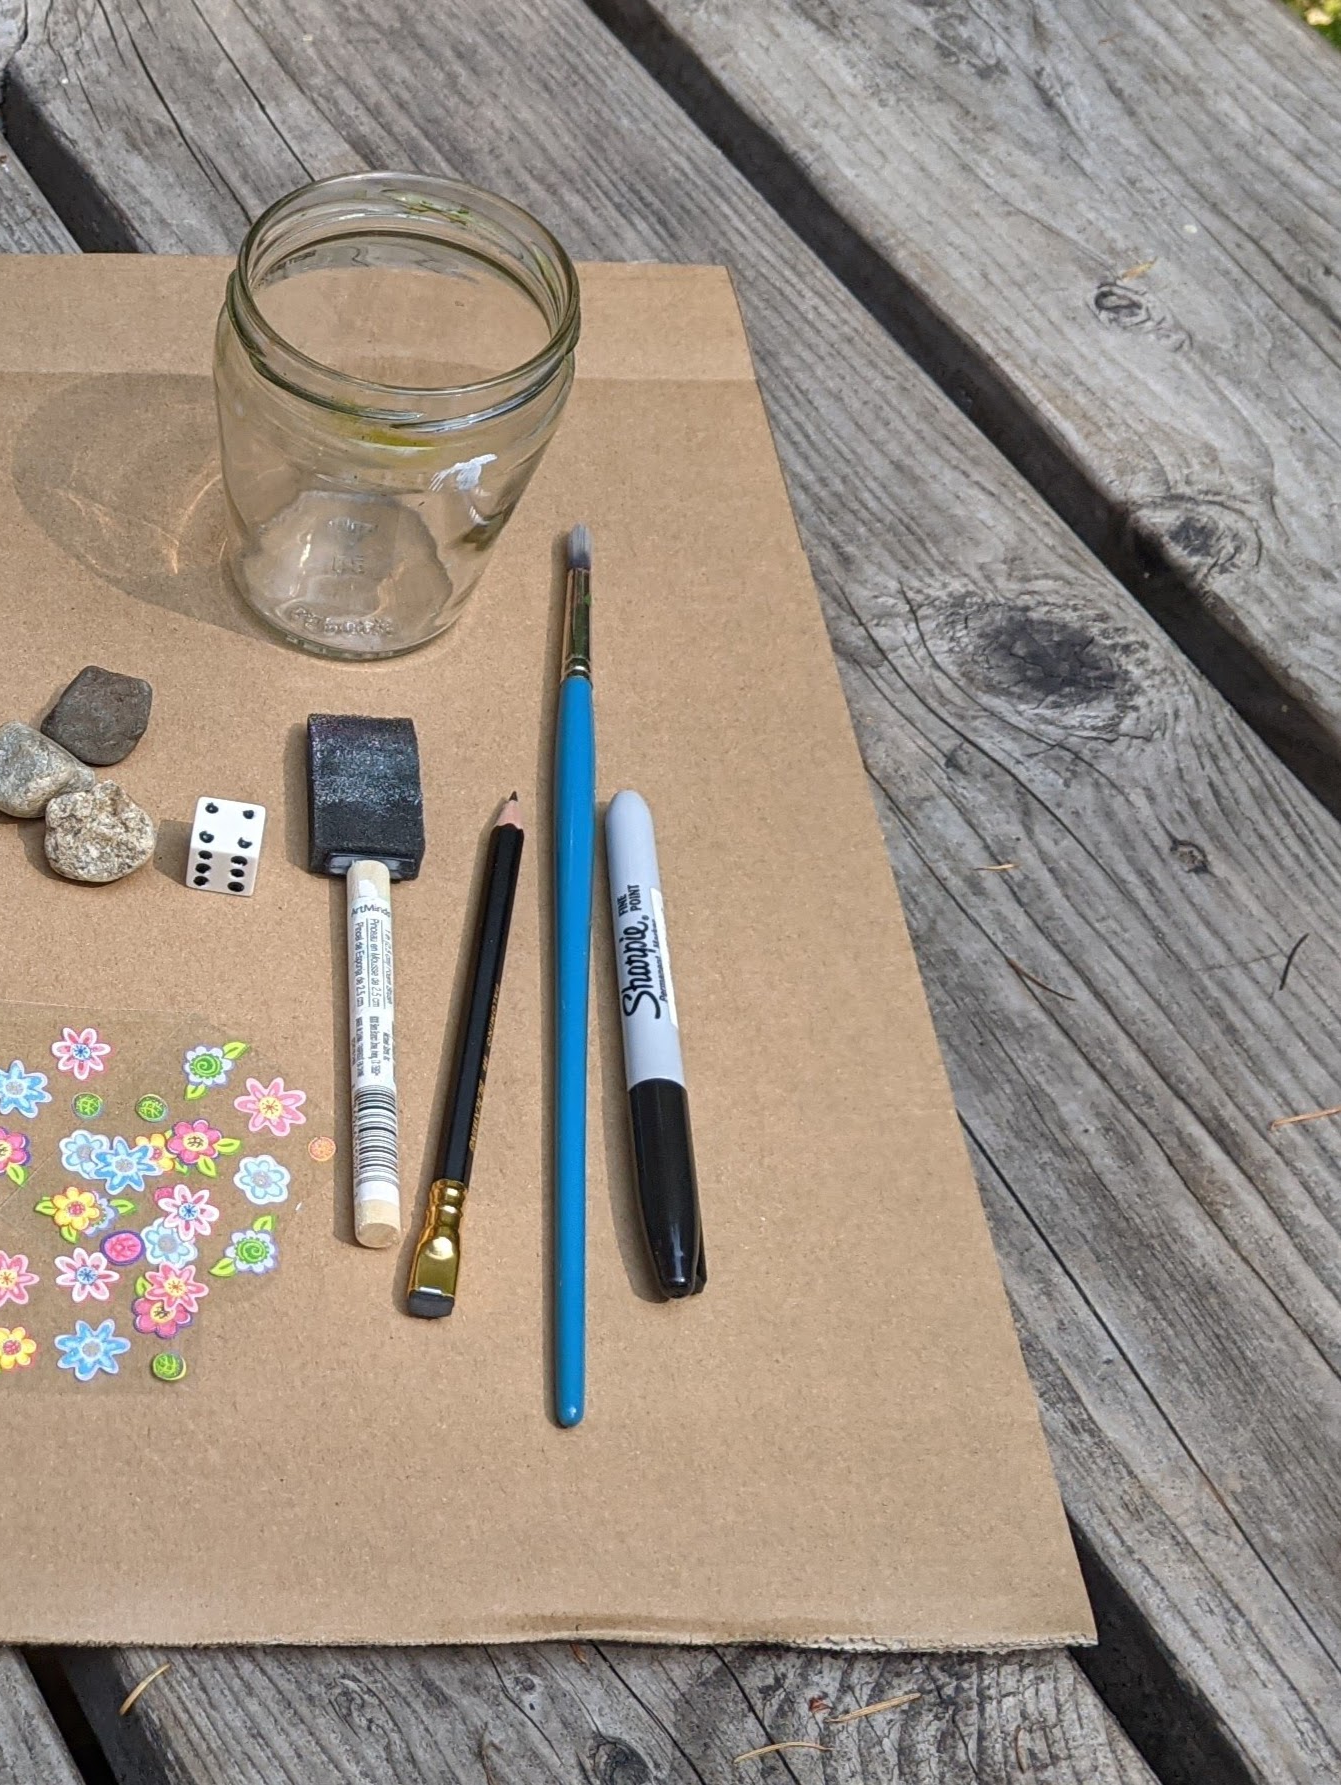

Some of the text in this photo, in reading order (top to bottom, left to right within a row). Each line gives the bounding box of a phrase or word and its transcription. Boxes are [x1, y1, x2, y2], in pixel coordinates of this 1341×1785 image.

[618, 894, 629, 917] FINE
[627, 884, 642, 911] POINT
[354, 922, 366, 942] Pincel
[369, 918, 379, 942] Pinceau
